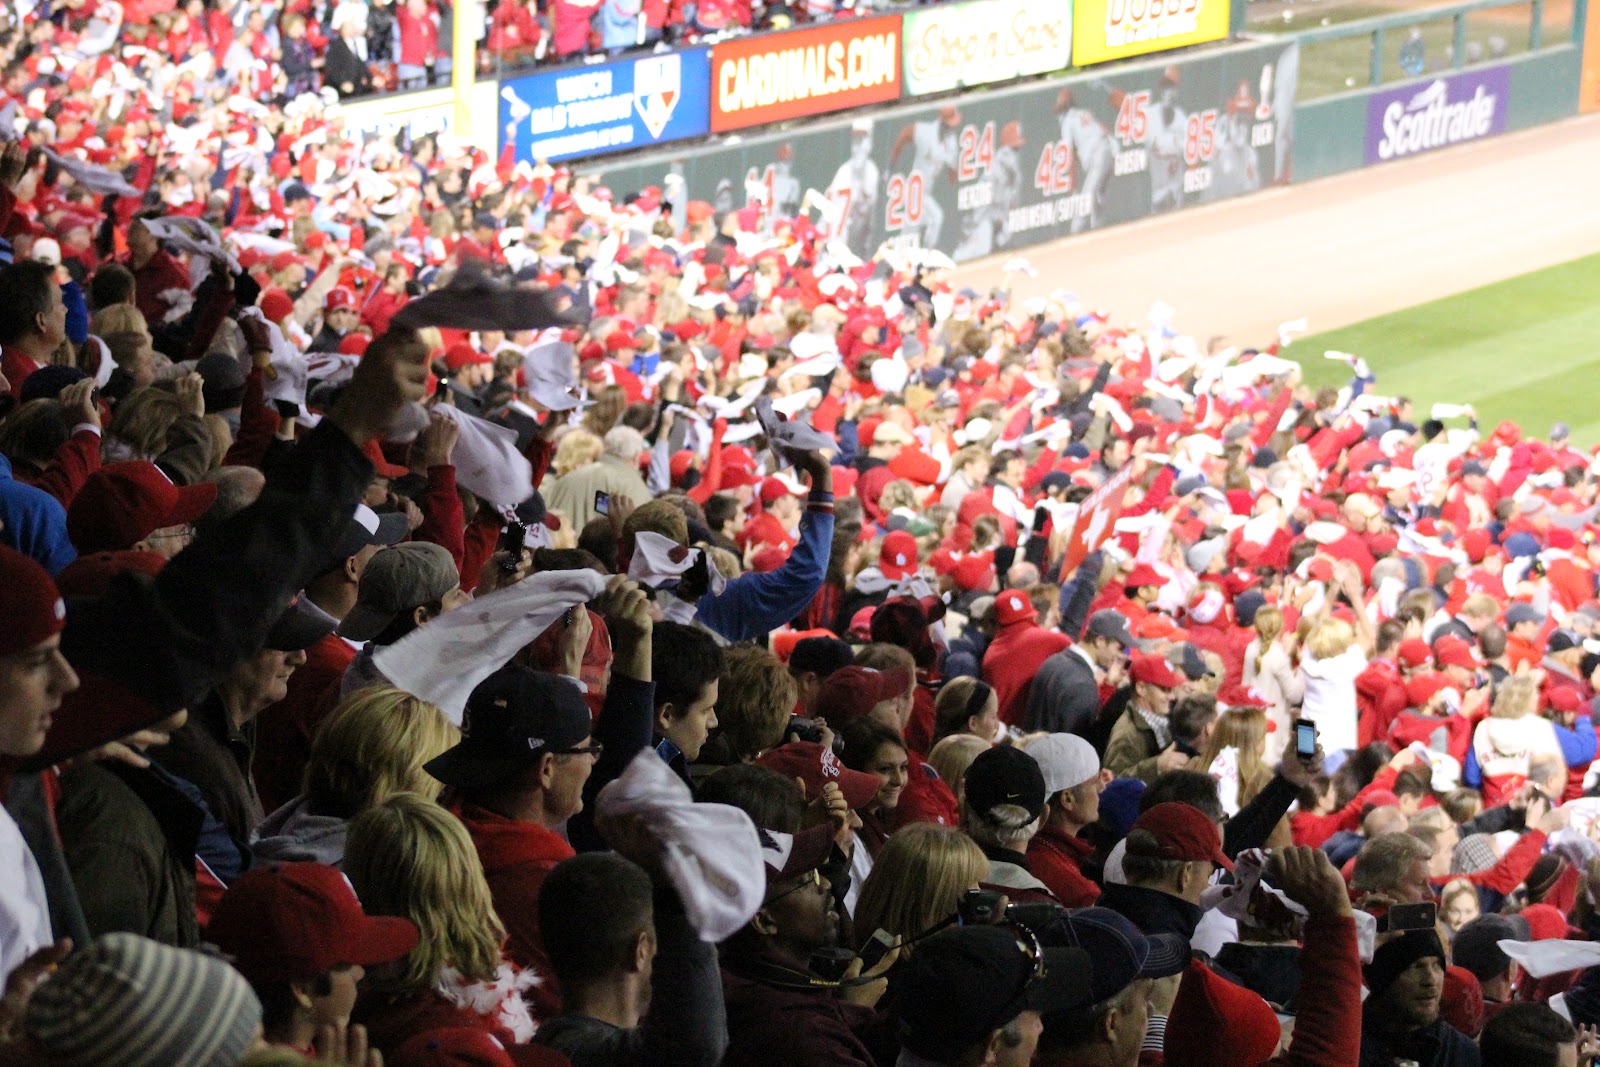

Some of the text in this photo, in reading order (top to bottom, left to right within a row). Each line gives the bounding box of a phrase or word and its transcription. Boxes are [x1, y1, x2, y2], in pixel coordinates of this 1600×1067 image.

[719, 32, 897, 113] CARDINALS.COM
[1115, 89, 1151, 146] 45
[1184, 108, 1218, 165] 85
[1378, 80, 1496, 159] Scottrade
[958, 120, 995, 181] 24
[1035, 140, 1073, 196] 42
[885, 170, 924, 231] 20
